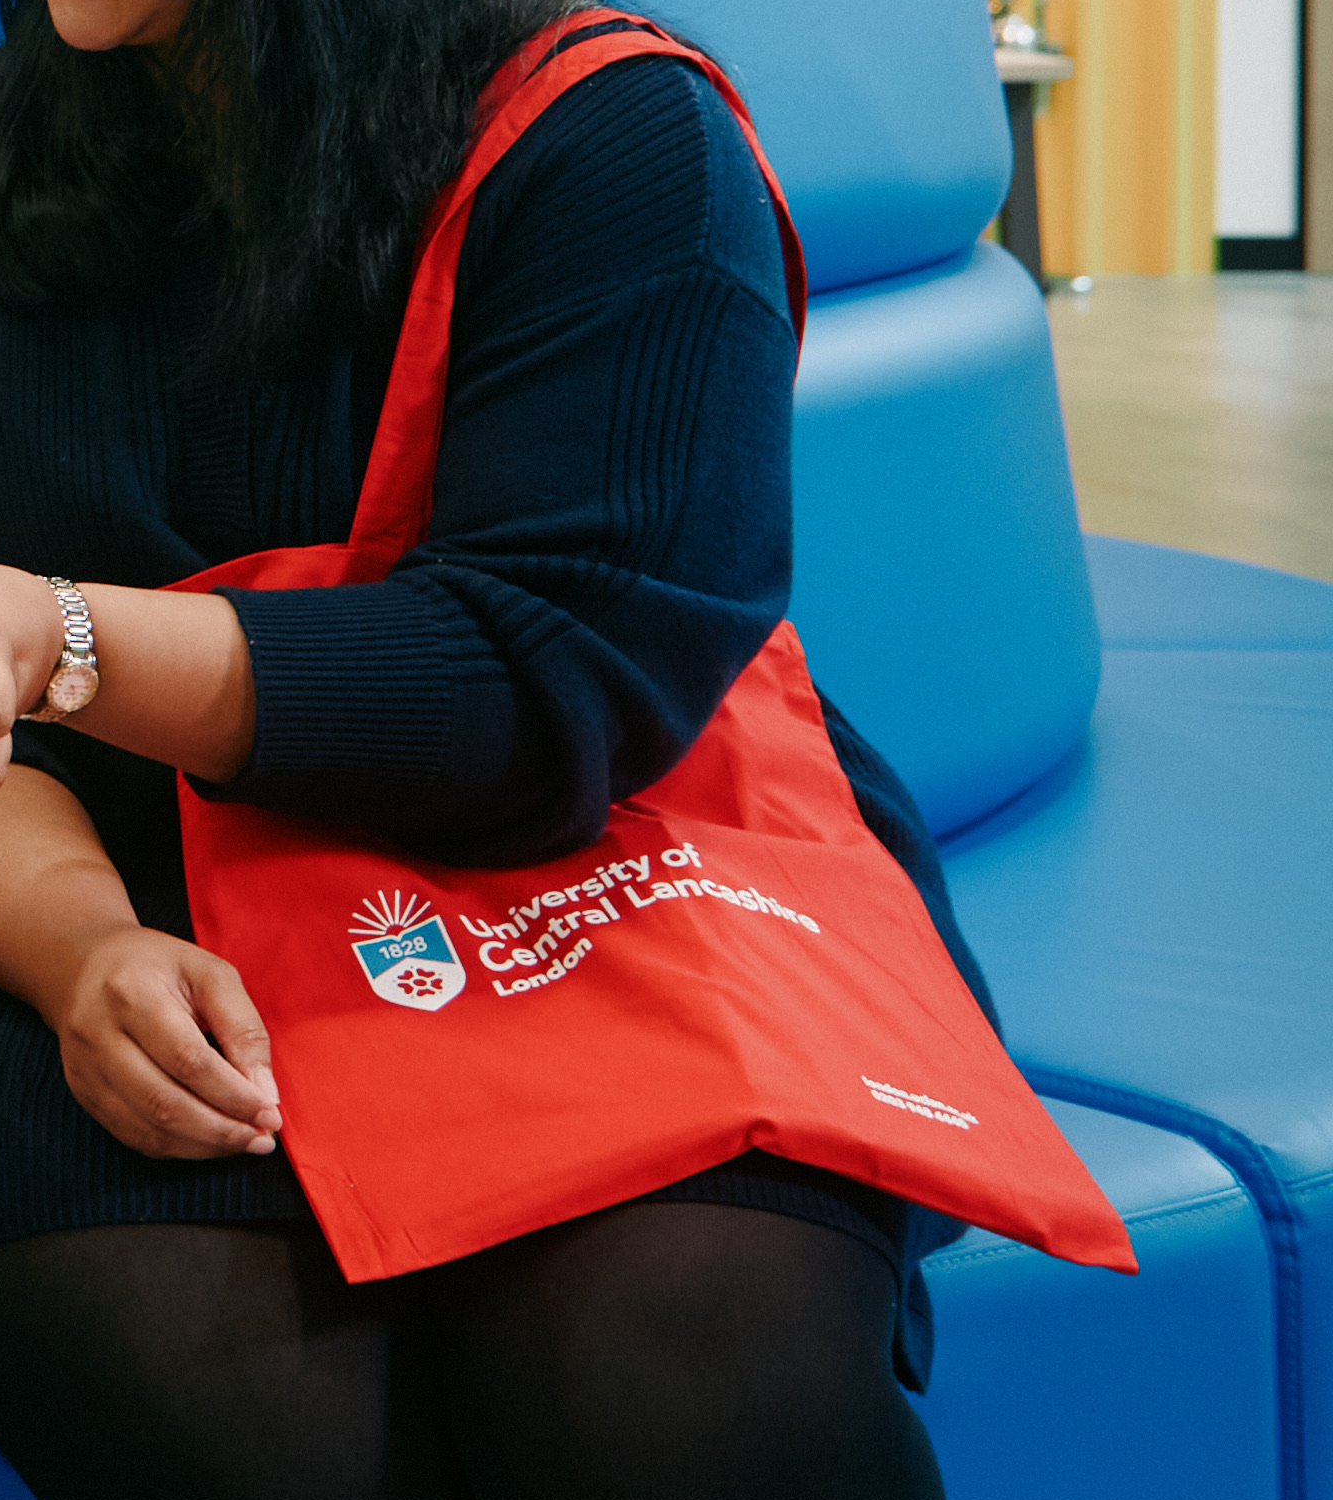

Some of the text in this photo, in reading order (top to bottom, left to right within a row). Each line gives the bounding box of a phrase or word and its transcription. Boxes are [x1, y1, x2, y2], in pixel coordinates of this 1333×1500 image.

[459, 841, 704, 941] University of
[478, 877, 822, 973] Central Lancashire
[378, 935, 429, 962] 1828
[492, 937, 593, 997] London
